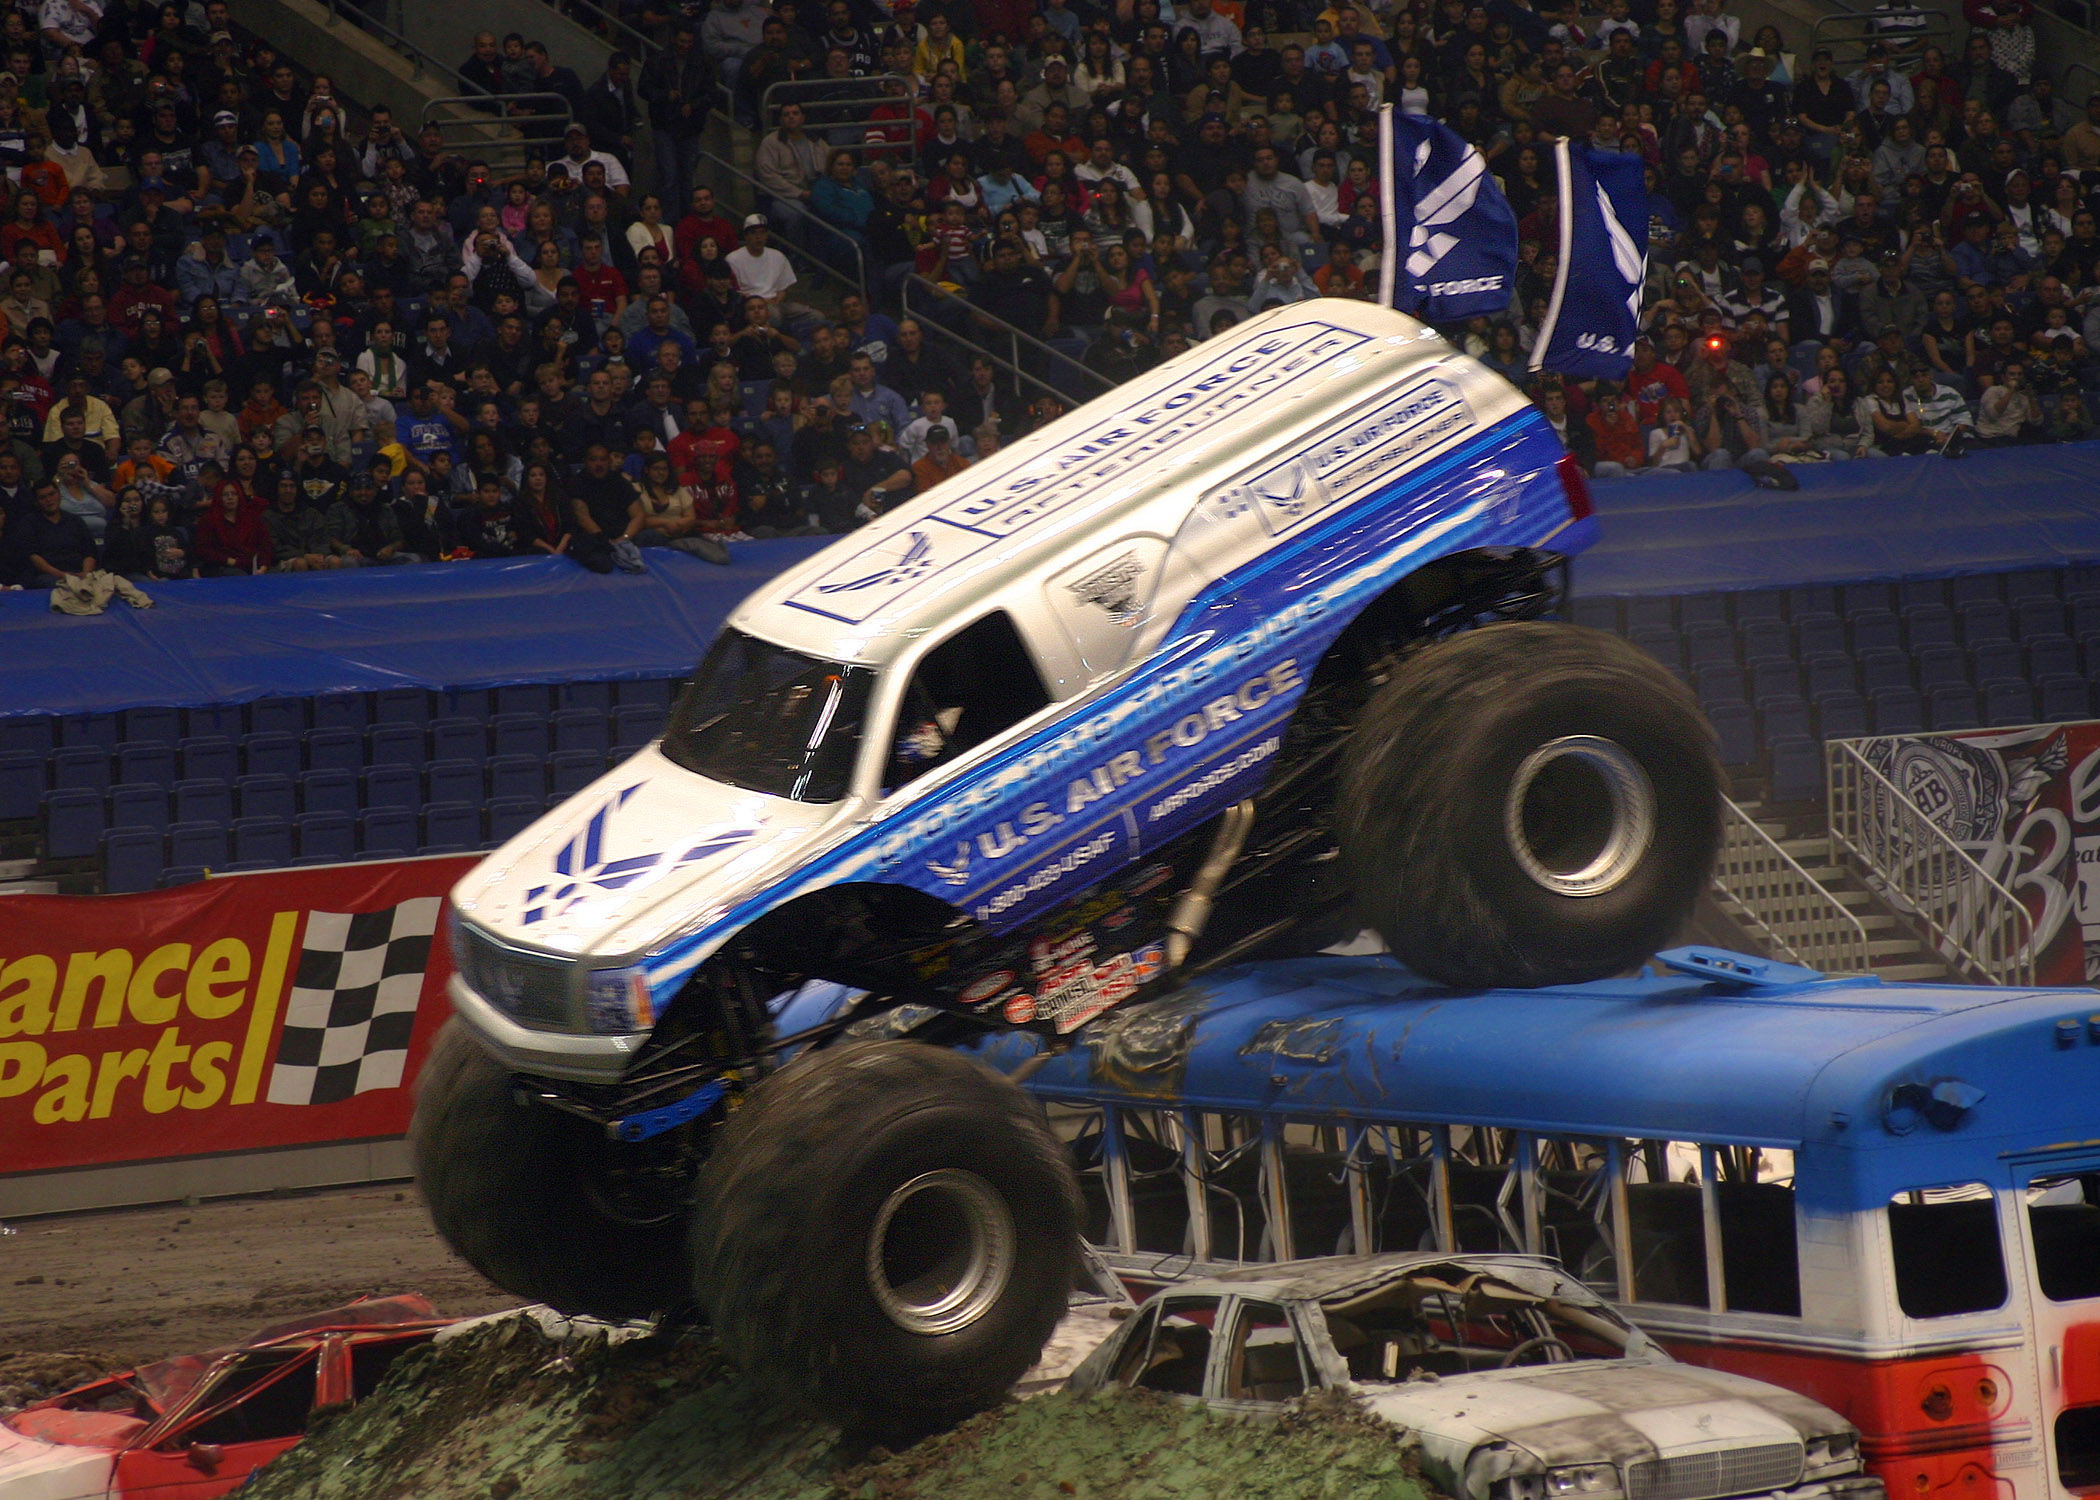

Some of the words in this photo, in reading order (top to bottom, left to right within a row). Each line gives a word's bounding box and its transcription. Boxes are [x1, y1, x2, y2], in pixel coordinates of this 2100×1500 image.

[1429, 275, 1504, 297] FORCE
[963, 473, 1055, 515] U.S.
[1060, 427, 1134, 471] AIR
[1137, 338, 1289, 424] FORCE
[1003, 339, 1341, 525] AFTERBURNER
[1349, 423, 1387, 449] AIR
[1382, 389, 1447, 432] FORCE
[976, 801, 1066, 859] U.S.
[1067, 749, 1148, 814] AIR
[1146, 657, 1304, 765] FORCE
[0, 937, 251, 1038] ance
[0, 1027, 233, 1125] Parts
